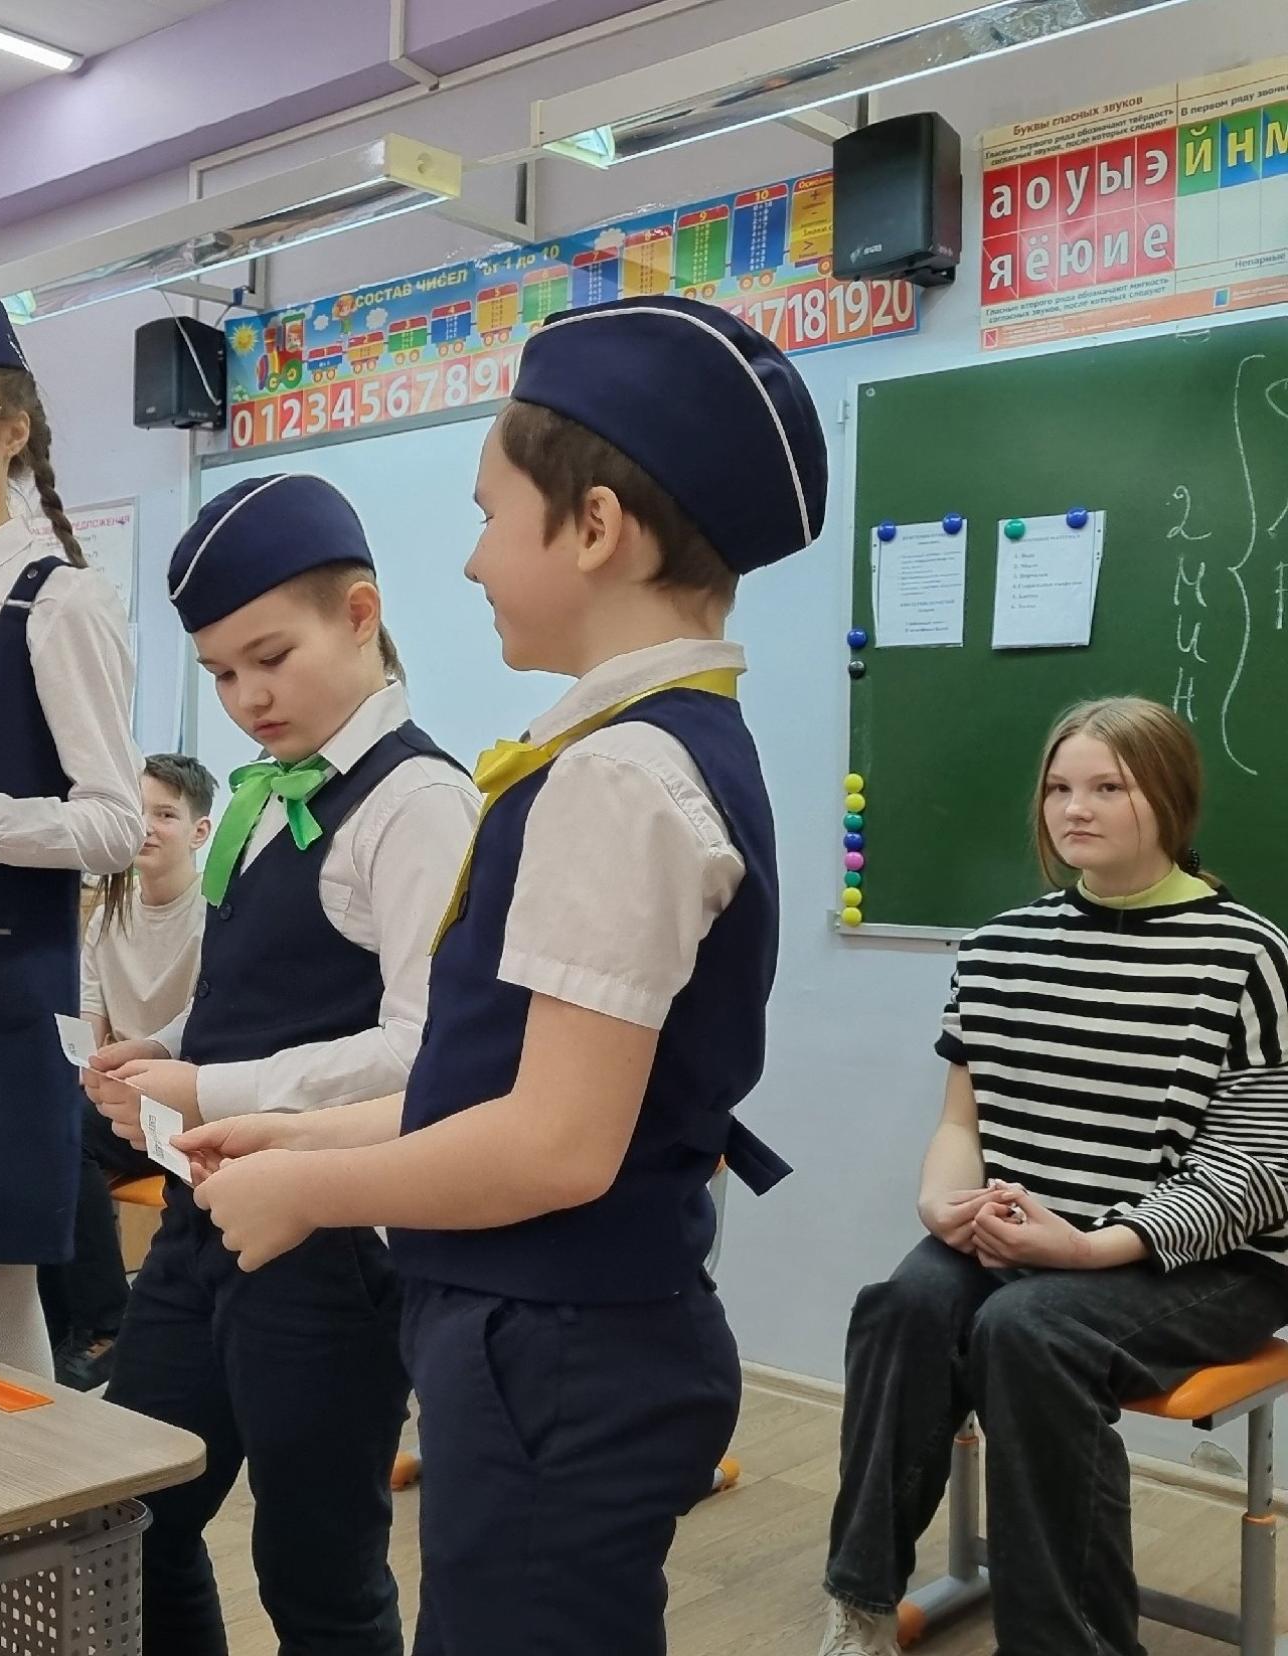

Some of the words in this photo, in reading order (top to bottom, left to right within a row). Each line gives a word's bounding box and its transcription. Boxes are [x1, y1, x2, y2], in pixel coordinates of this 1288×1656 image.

[1013, 120, 1050, 137] Буквы
[1052, 106, 1100, 127] гласных
[1103, 96, 1143, 115] звуков
[1077, 120, 1127, 137] обозначают
[1130, 119, 1168, 133] следуют
[1190, 100, 1228, 114] первом
[1230, 93, 1255, 108] ряду
[1185, 125, 1212, 176] й
[1227, 127, 1254, 168] н
[989, 185, 1011, 219] а
[1026, 177, 1050, 211] о
[1065, 166, 1090, 215] у
[1100, 156, 1132, 195] ы
[1145, 150, 1168, 185] э
[354, 283, 412, 308] СОСТАВ
[416, 269, 468, 292] ЧИСЕЛ
[483, 263, 498, 277] от
[515, 253, 536, 270] до
[541, 244, 561, 261] 10
[988, 254, 1011, 290] я
[1026, 233, 1050, 282] ё
[1060, 239, 1093, 277] ю
[1103, 231, 1129, 268] и
[1144, 222, 1168, 259] е
[232, 409, 253, 447] 0
[261, 404, 275, 442] 1
[281, 398, 302, 439] 2
[306, 392, 328, 434] 3
[331, 387, 355, 428] 4
[359, 380, 382, 424] 5
[386, 375, 410, 418] 6
[415, 370, 439, 414] 7
[444, 364, 469, 408] 8
[474, 357, 500, 401] 9
[788, 288, 827, 343] 18
[828, 280, 869, 334] 19
[872, 279, 912, 327] 20
[1166, 485, 1212, 540] 2
